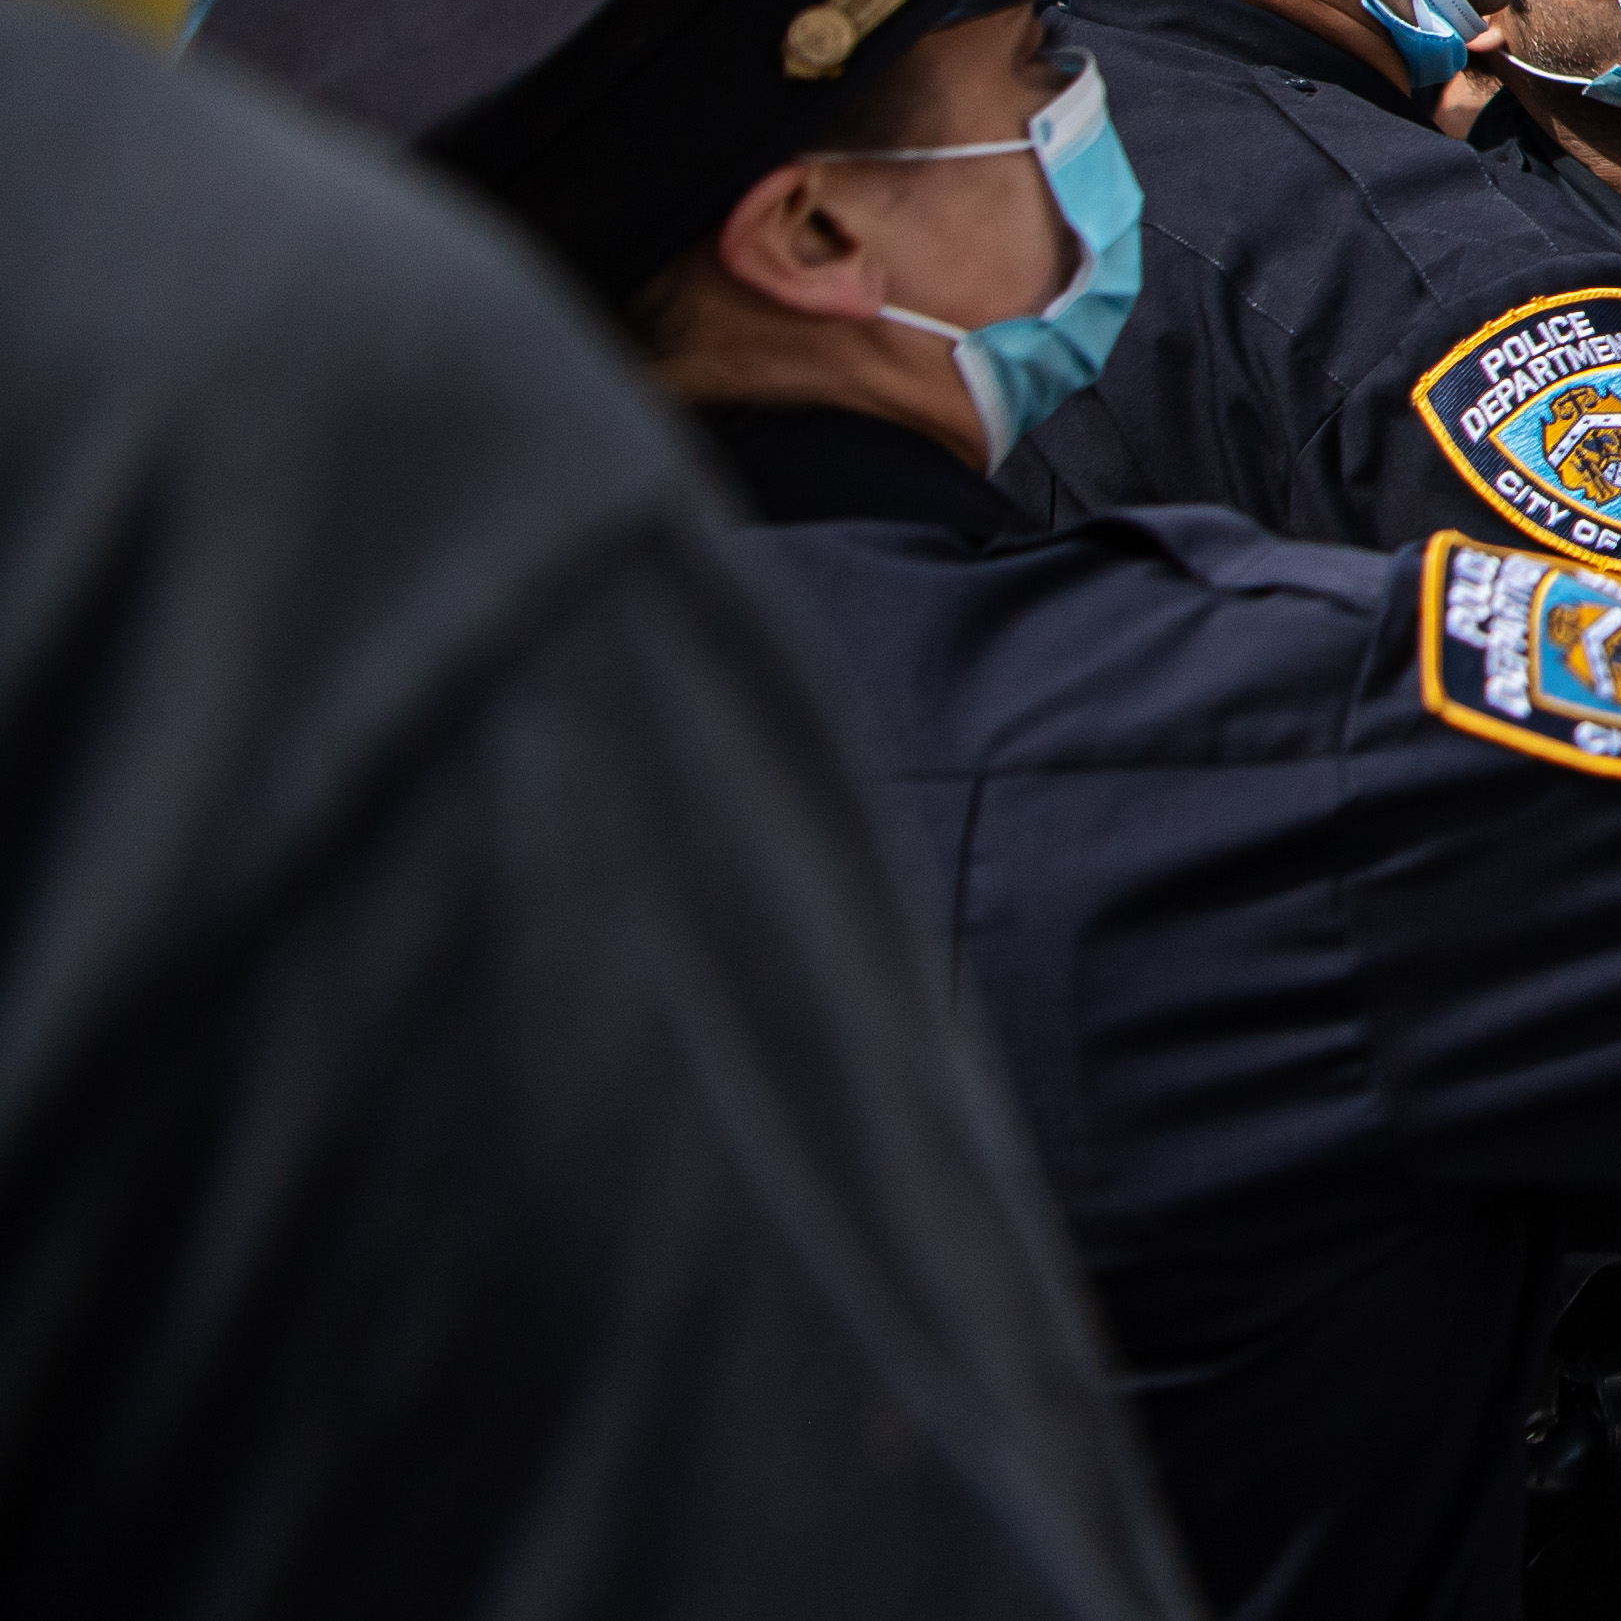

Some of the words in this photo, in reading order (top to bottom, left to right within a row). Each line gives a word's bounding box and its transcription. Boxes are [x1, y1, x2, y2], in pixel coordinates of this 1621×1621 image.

[1479, 311, 1595, 384] POLICE
[1495, 470, 1571, 527] CITY
[1572, 519, 1621, 550] OF
